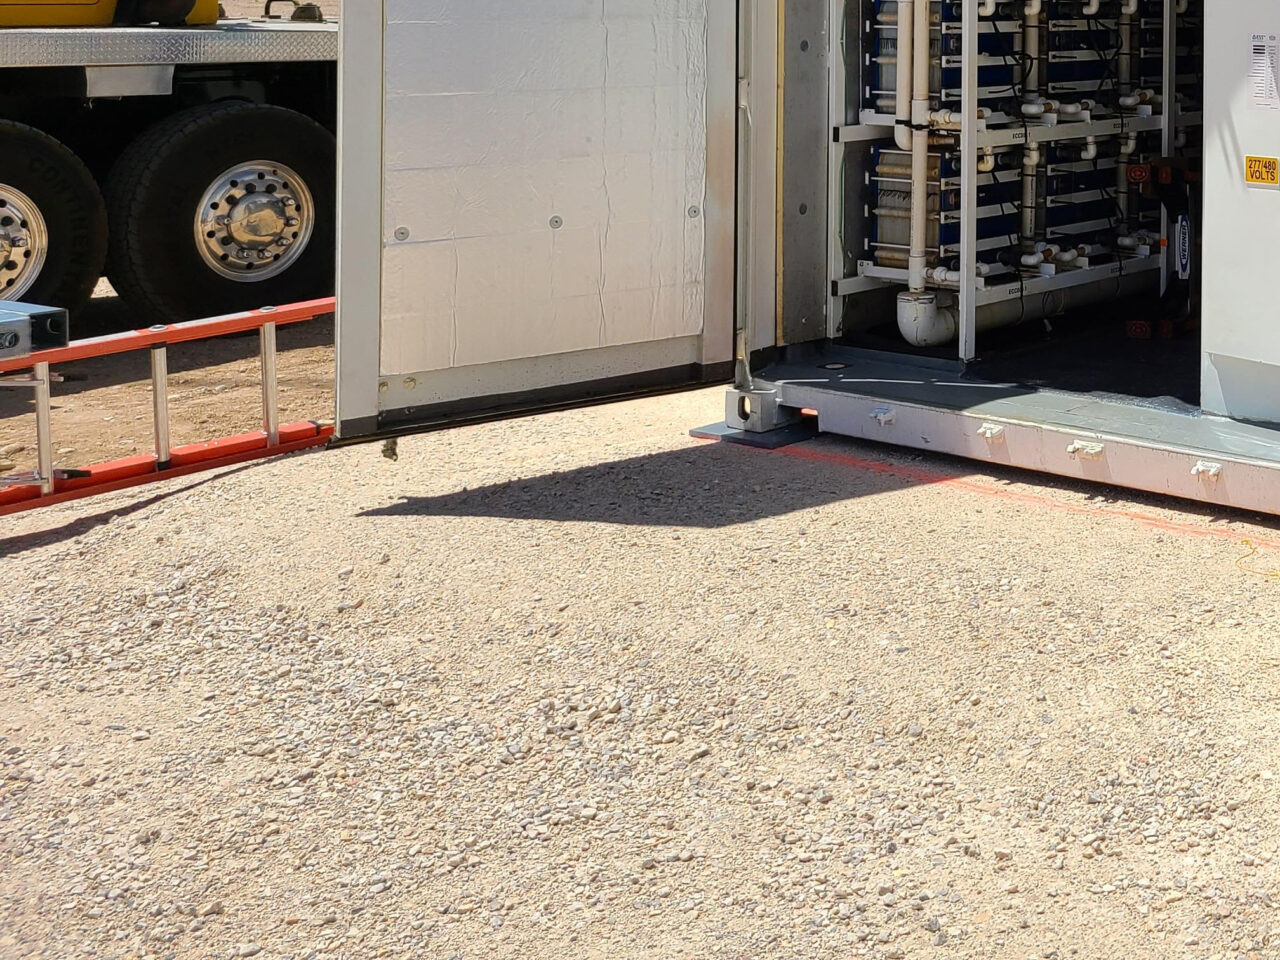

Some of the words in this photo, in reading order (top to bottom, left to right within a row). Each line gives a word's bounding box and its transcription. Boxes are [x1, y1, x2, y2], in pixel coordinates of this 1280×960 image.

[1248, 159, 1277, 171] 277/480
[1249, 169, 1276, 181] VOLTS
[1180, 224, 1189, 260] WERNER
